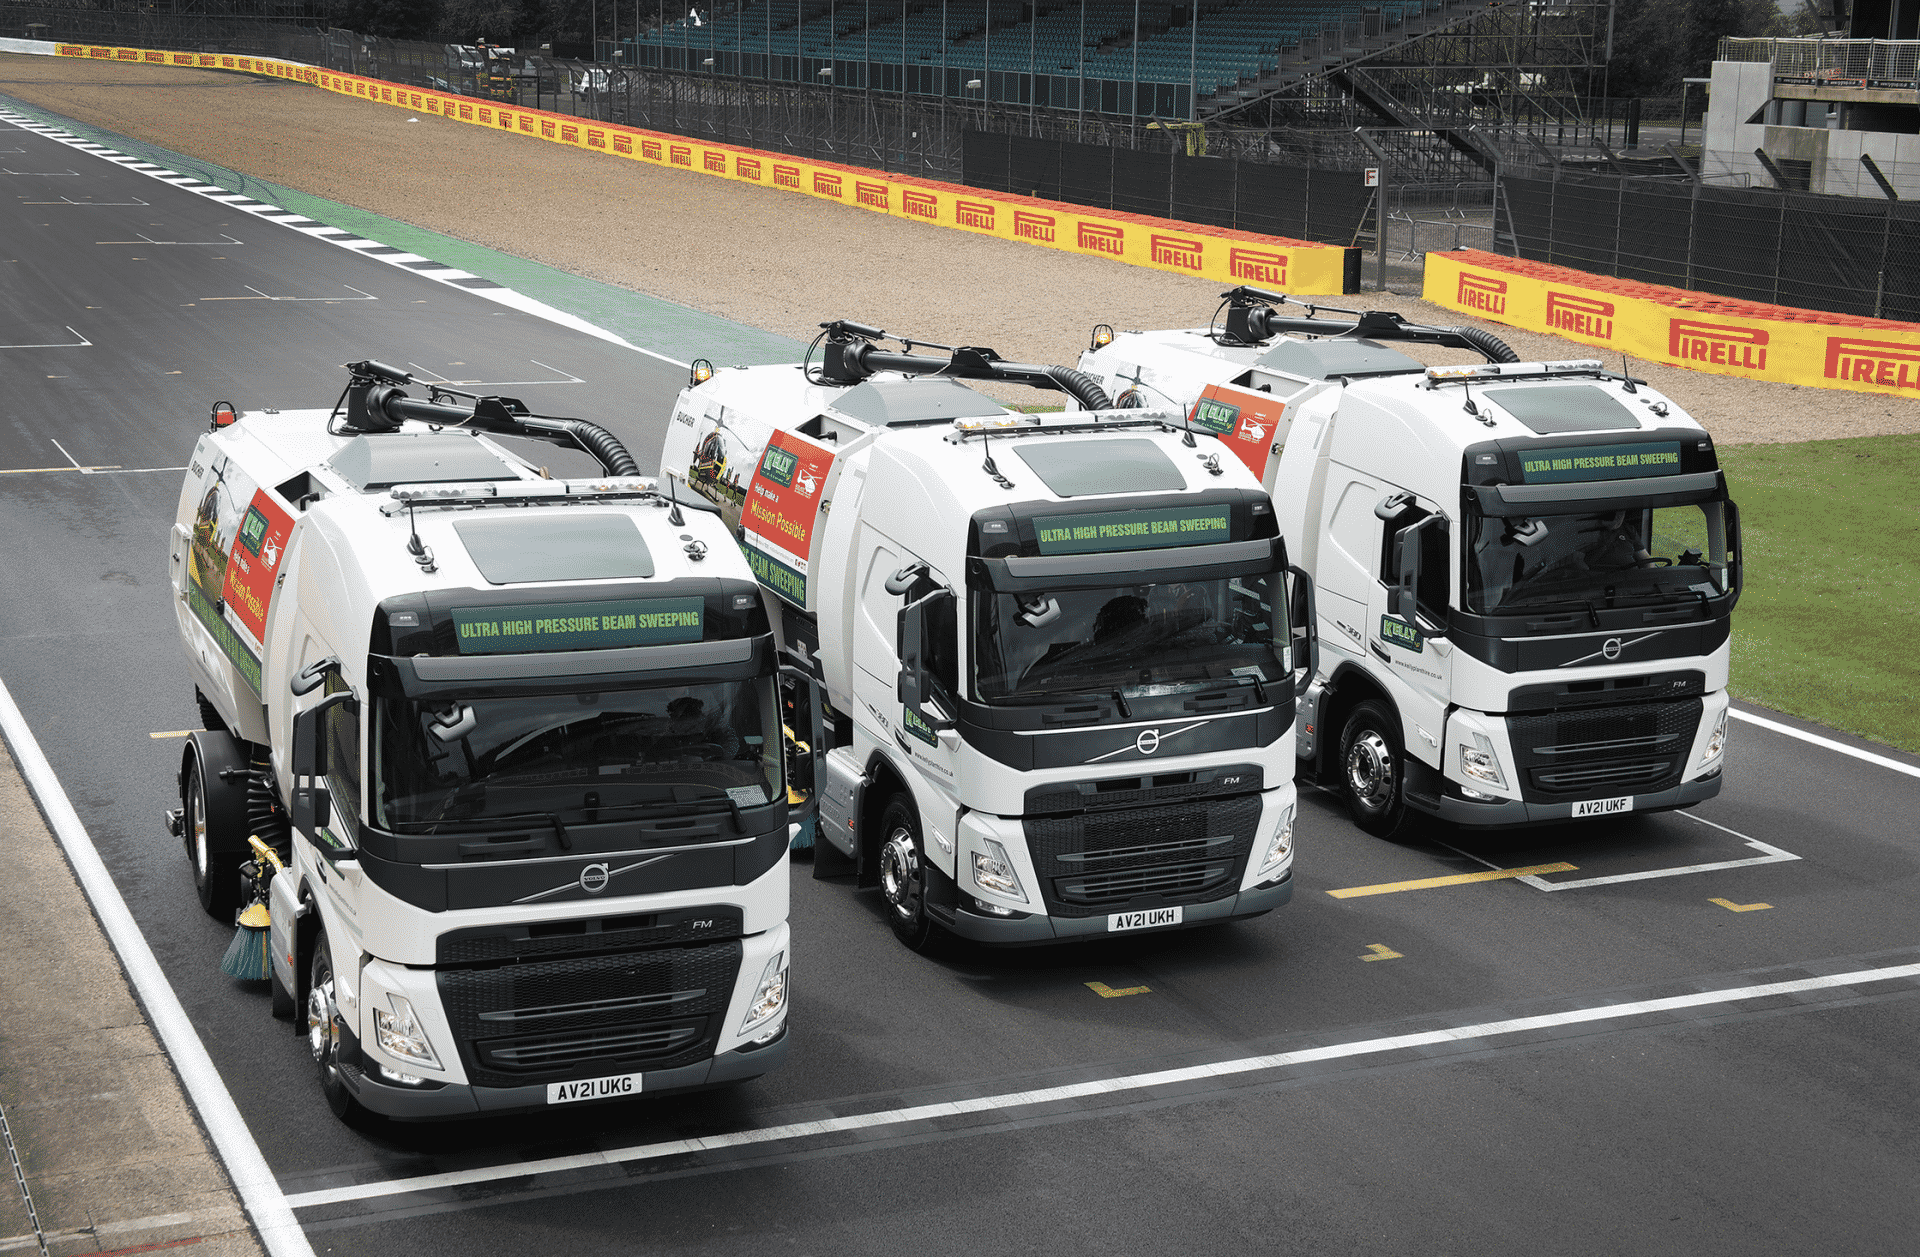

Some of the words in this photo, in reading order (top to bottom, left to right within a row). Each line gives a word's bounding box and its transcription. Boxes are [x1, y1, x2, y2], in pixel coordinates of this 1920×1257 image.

[704, 151, 725, 173] PIRELLI
[737, 157, 761, 181] PIRELLI
[773, 164, 800, 188] PIRELLI
[814, 172, 842, 198] PIRELLI
[1366, 170, 1376, 184] F
[856, 181, 889, 209] PIRELLI
[903, 190, 937, 219] PIRELLI
[956, 200, 994, 230] PIRELLI
[1014, 211, 1055, 242] PIRELLI
[1078, 222, 1123, 255] PIRELLI
[1151, 234, 1203, 270] PIRELLI
[1230, 248, 1287, 286] PIRELLI
[1458, 272, 1507, 315] PIRELLI
[1546, 291, 1614, 340] PIRELLI
[1669, 318, 1769, 370] PIRELLI
[1824, 337, 1920, 390] PIREL
[1083, 371, 1104, 385] UCHER
[677, 411, 695, 428] BUCHER
[1197, 402, 1233, 423] KELLY
[763, 450, 794, 473] KELLY
[1525, 460, 1551, 472] ULTRA
[1552, 459, 1572, 471] HIGH
[1574, 456, 1615, 469] PRESSURE
[1617, 455, 1638, 466] BEAM
[1640, 452, 1678, 464] SWEEPING
[750, 499, 776, 526] Mission
[776, 511, 806, 541] Possible
[1040, 528, 1071, 542] ULTRA
[1073, 526, 1097, 540] HIGH
[1099, 523, 1149, 538] PRESSURE
[1151, 521, 1178, 534] BEAM
[1180, 517, 1226, 532] SWEEPING
[750, 551, 768, 580] BEAM
[770, 562, 804, 602] SWEEPING
[461, 621, 500, 638] ULTRA
[502, 620, 532, 635] HIGH
[536, 616, 599, 634] PRESSURE
[602, 615, 636, 631] BEAM
[639, 611, 699, 628] SWEEPING
[1384, 620, 1417, 641] KELLY
[1224, 777, 1240, 785] FM
[1579, 801, 1603, 815] AV21
[1606, 799, 1627, 811] UKF
[693, 919, 713, 929] FM
[1116, 913, 1145, 928] AV21
[1149, 909, 1174, 924] UKH
[558, 1082, 594, 1100] AV21
[600, 1077, 632, 1094] UKG
